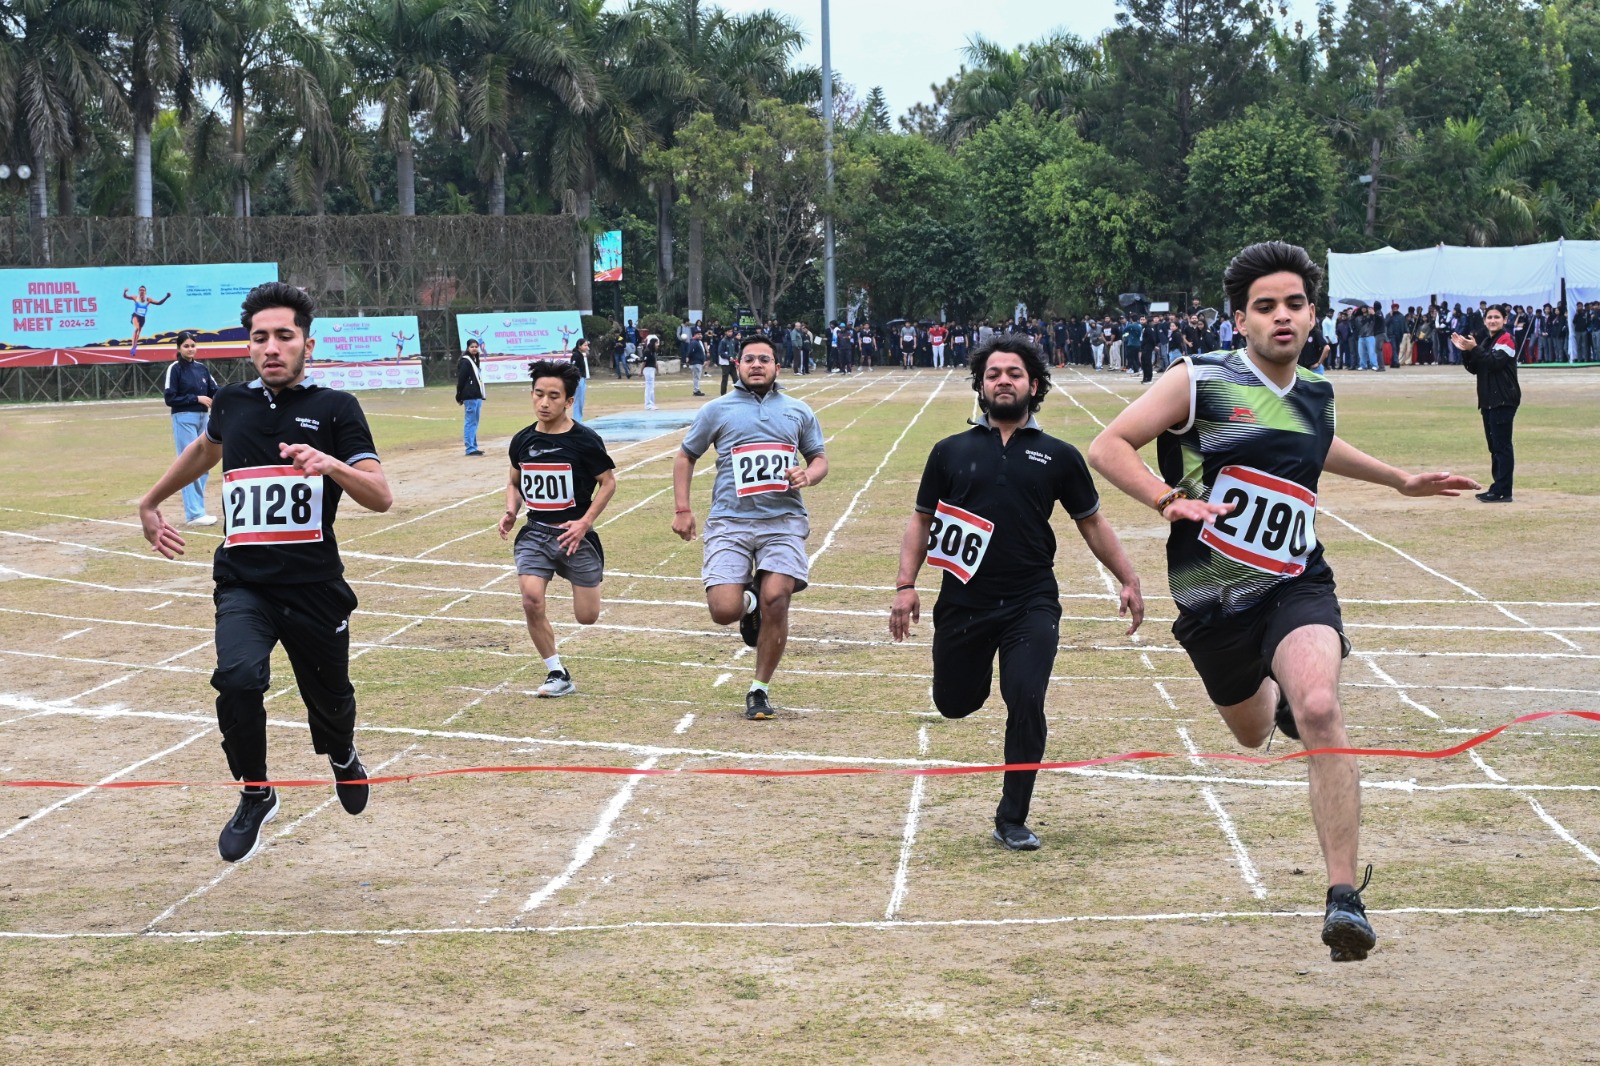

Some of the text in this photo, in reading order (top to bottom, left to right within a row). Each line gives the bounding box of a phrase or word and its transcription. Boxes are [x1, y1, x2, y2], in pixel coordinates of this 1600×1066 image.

[28, 282, 80, 294] ANNUAL
[12, 297, 97, 314] ATHLETICS
[14, 317, 95, 332] MEET 2024-25
[524, 474, 568, 500] 2201
[230, 483, 312, 528] 2128
[1214, 488, 1308, 557] 2190
